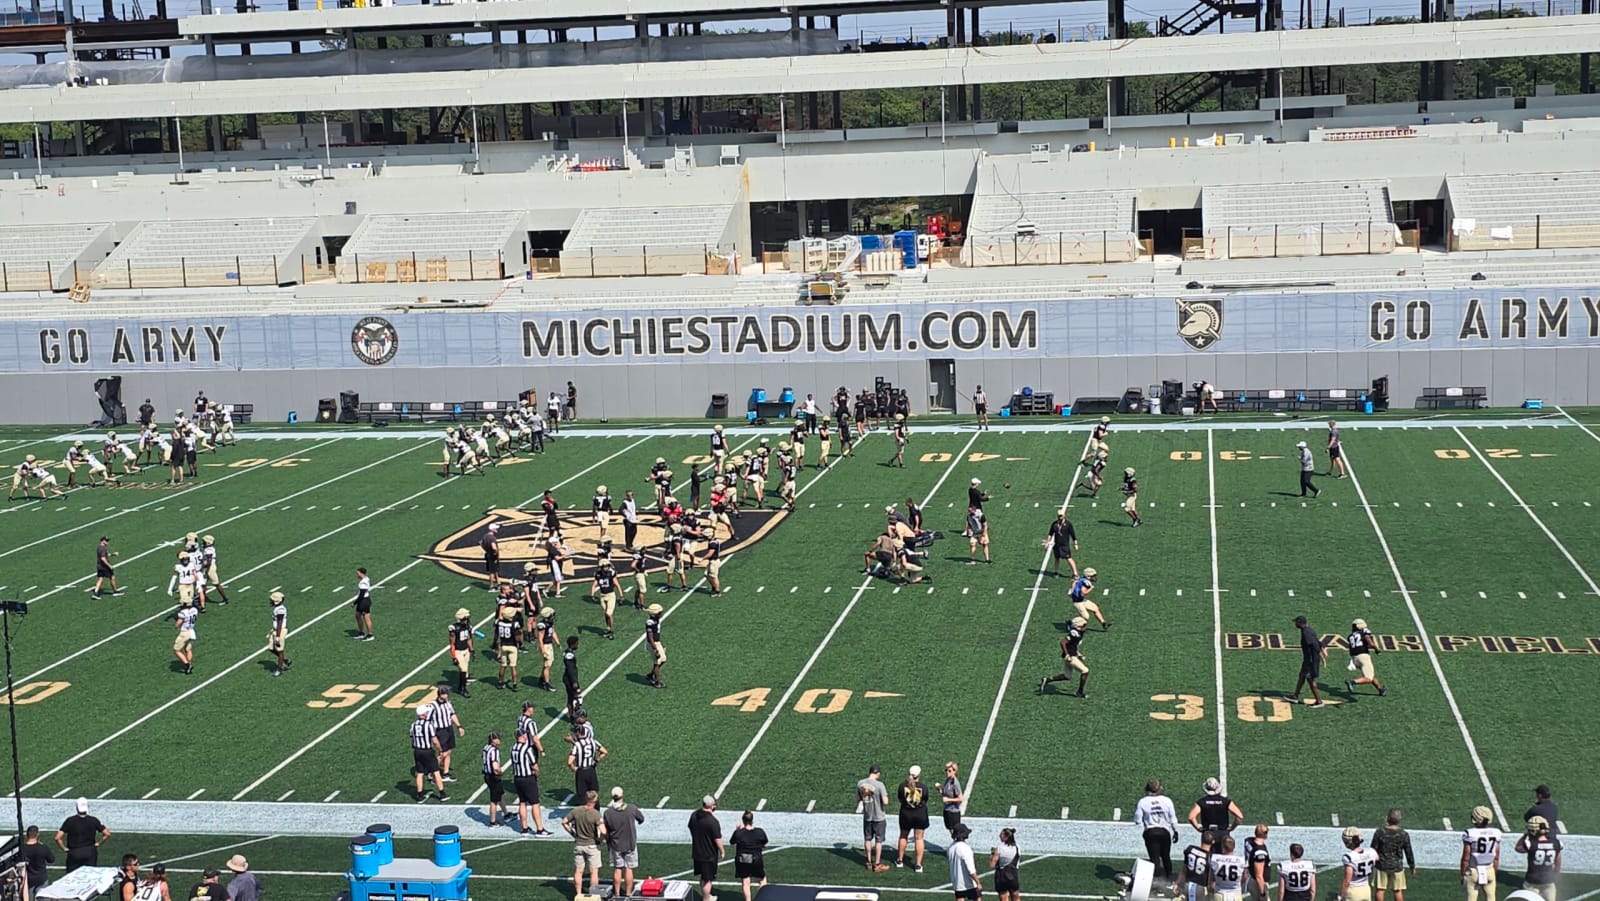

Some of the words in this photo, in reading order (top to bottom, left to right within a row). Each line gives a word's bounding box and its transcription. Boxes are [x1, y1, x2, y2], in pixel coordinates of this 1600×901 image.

[1369, 299, 1431, 342] GO
[1458, 296, 1600, 341] ARMY
[39, 326, 90, 364] GO
[111, 322, 227, 363] ARMY
[520, 309, 1038, 358] MICHIESTADIUM.COM
[1225, 632, 1425, 652] BLAK
[305, 683, 438, 709] 50
[711, 687, 853, 714] 40
[1149, 693, 1293, 722] 30
[584, 745, 592, 758] S
[1477, 837, 1497, 854] 67
[1187, 854, 1207, 875] 96
[1533, 850, 1556, 866] 93
[1217, 865, 1239, 882] 46
[1288, 871, 1310, 888] 98
